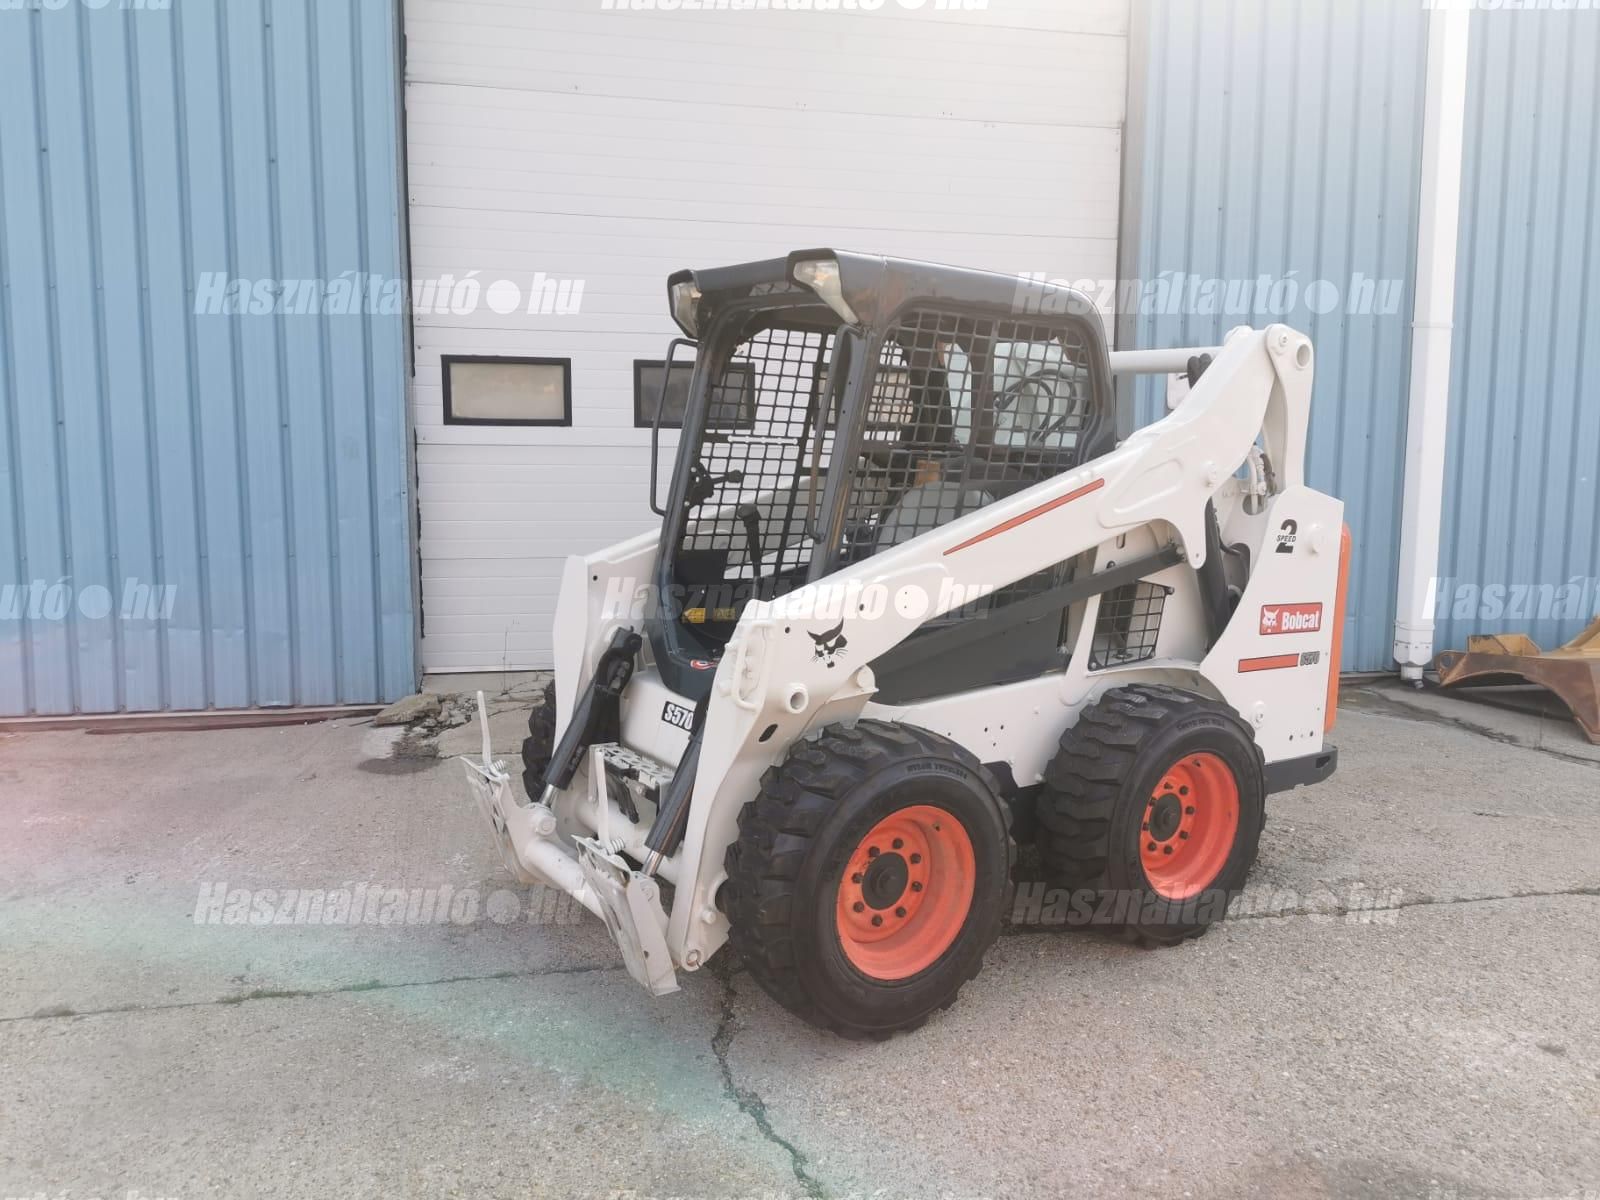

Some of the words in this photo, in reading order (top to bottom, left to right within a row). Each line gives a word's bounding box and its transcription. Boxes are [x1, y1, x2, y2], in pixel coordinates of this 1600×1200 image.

[1276, 534, 1297, 543] SPEED
[1281, 611, 1320, 631] Bobcat
[664, 703, 694, 730] S570
